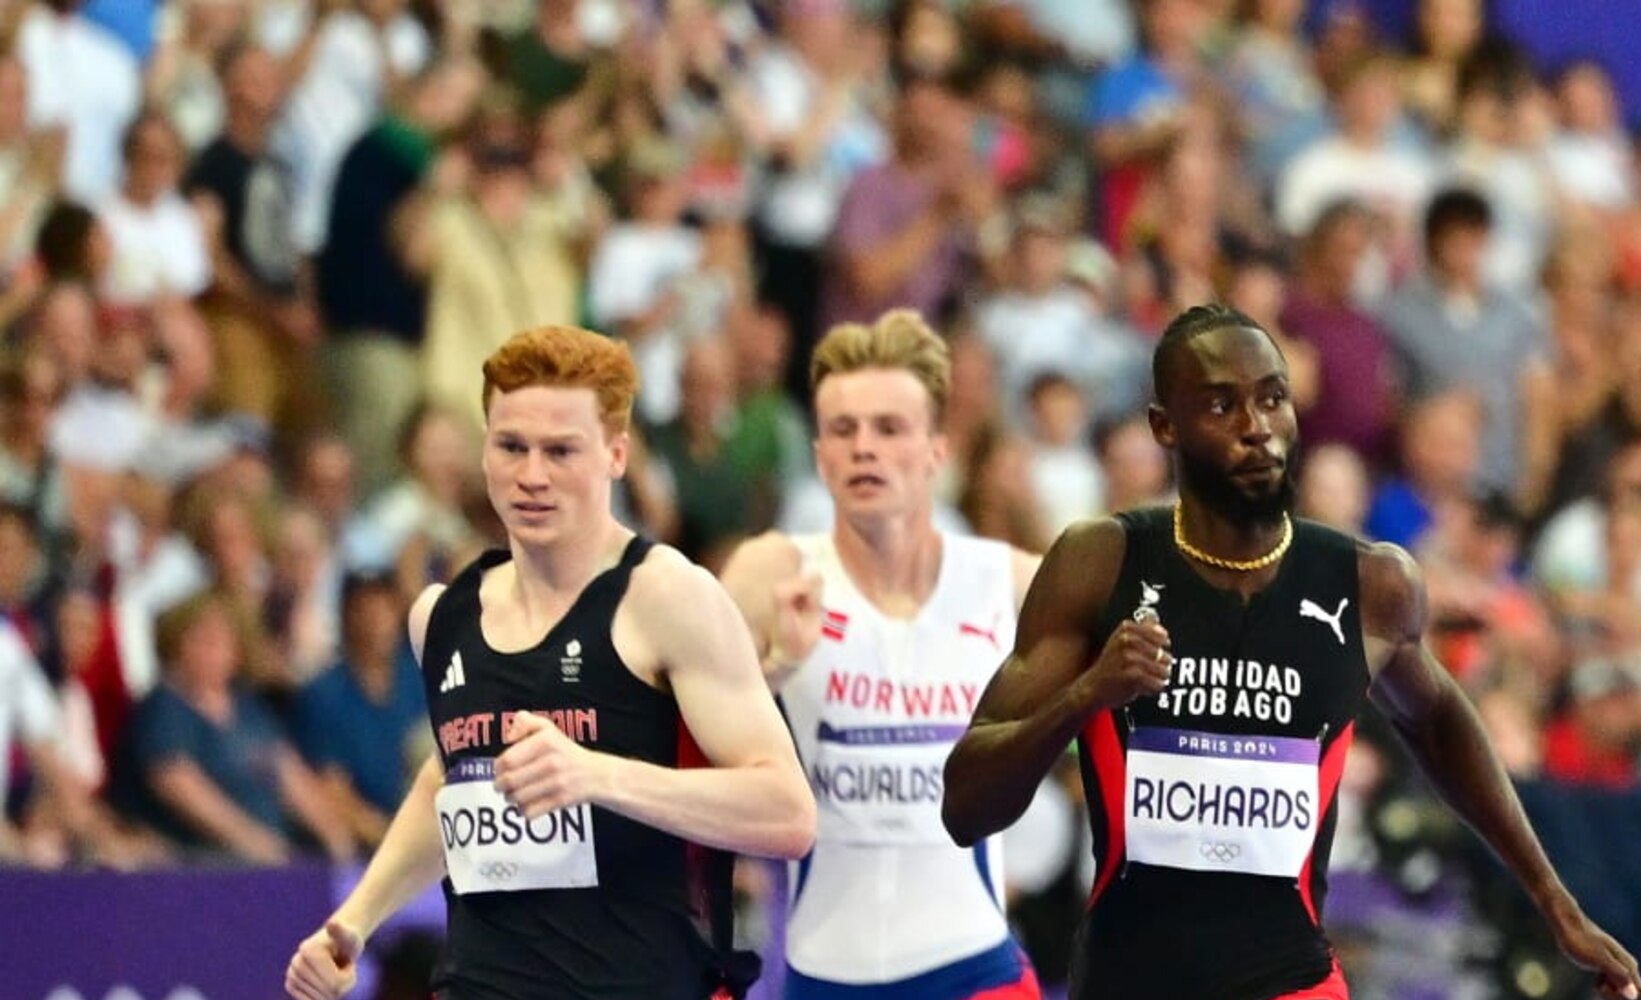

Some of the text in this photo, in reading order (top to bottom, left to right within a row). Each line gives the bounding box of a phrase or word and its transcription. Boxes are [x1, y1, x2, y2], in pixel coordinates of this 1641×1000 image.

[825, 670, 977, 717] NORWAY
[1171, 656, 1301, 697] RINIDAD
[1178, 735, 1277, 756] PARIS 2024
[440, 802, 586, 850] DOBSON
[1132, 776, 1311, 831] RICHARDS
